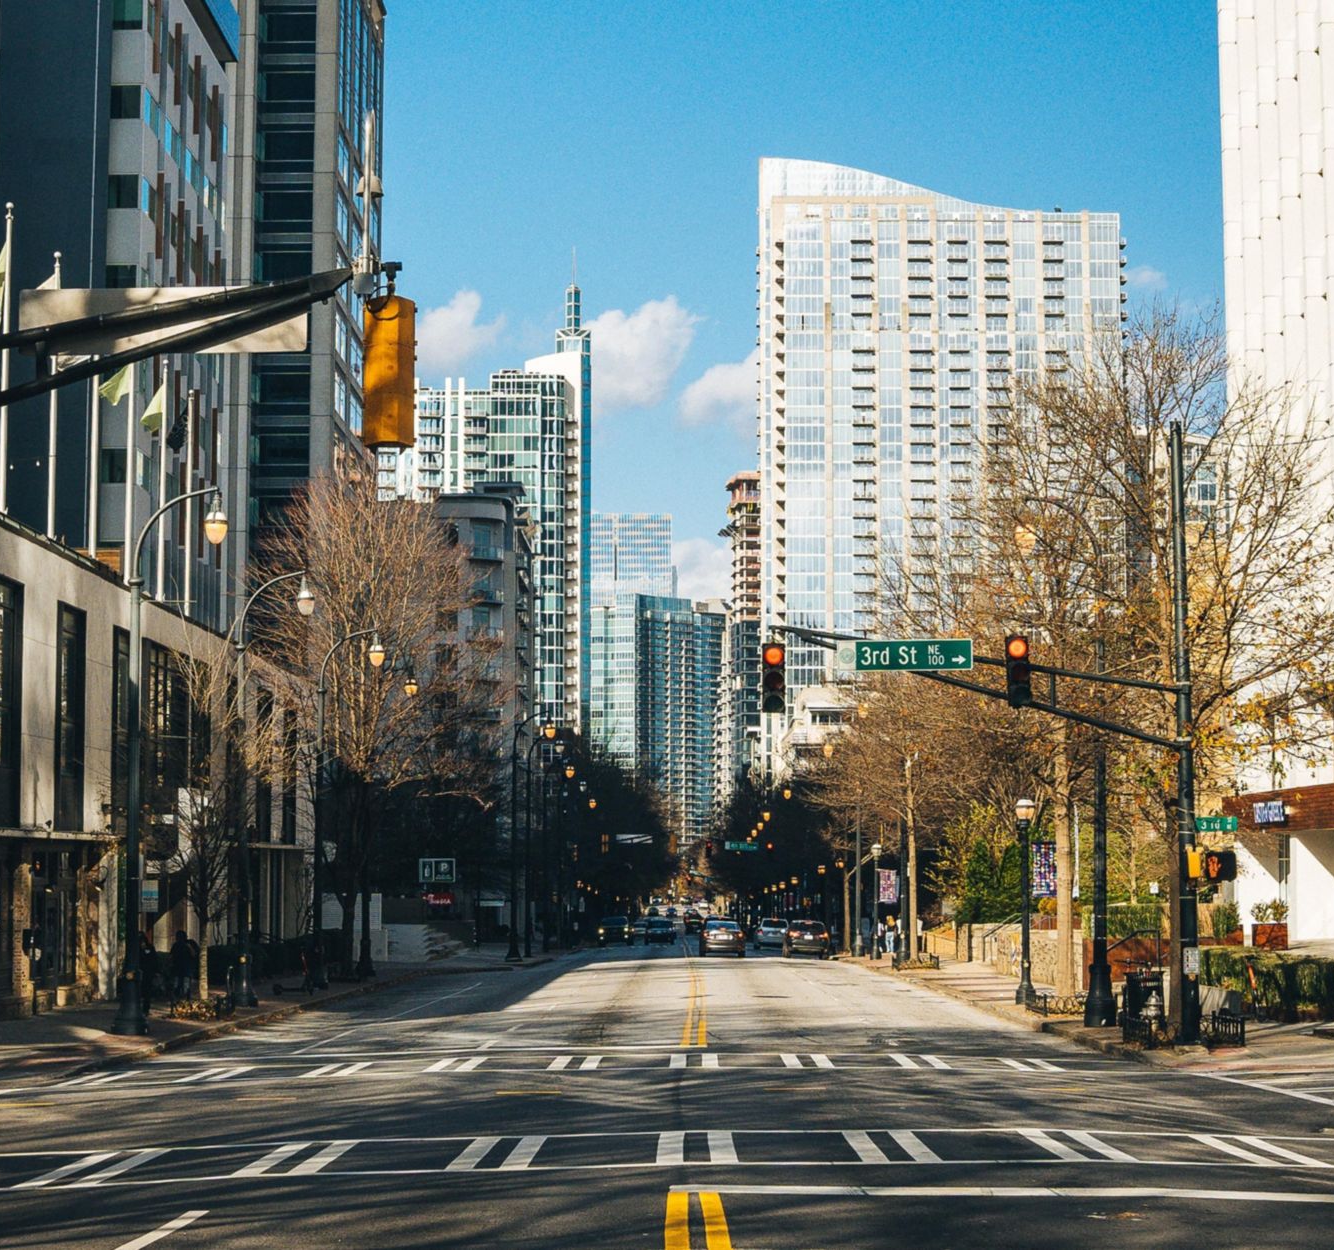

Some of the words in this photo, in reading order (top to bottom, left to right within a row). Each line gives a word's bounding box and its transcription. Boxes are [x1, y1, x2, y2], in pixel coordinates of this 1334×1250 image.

[928, 644, 941, 655] NE
[860, 646, 890, 666] 3rd
[898, 646, 917, 665] St
[928, 655, 945, 665] 100
